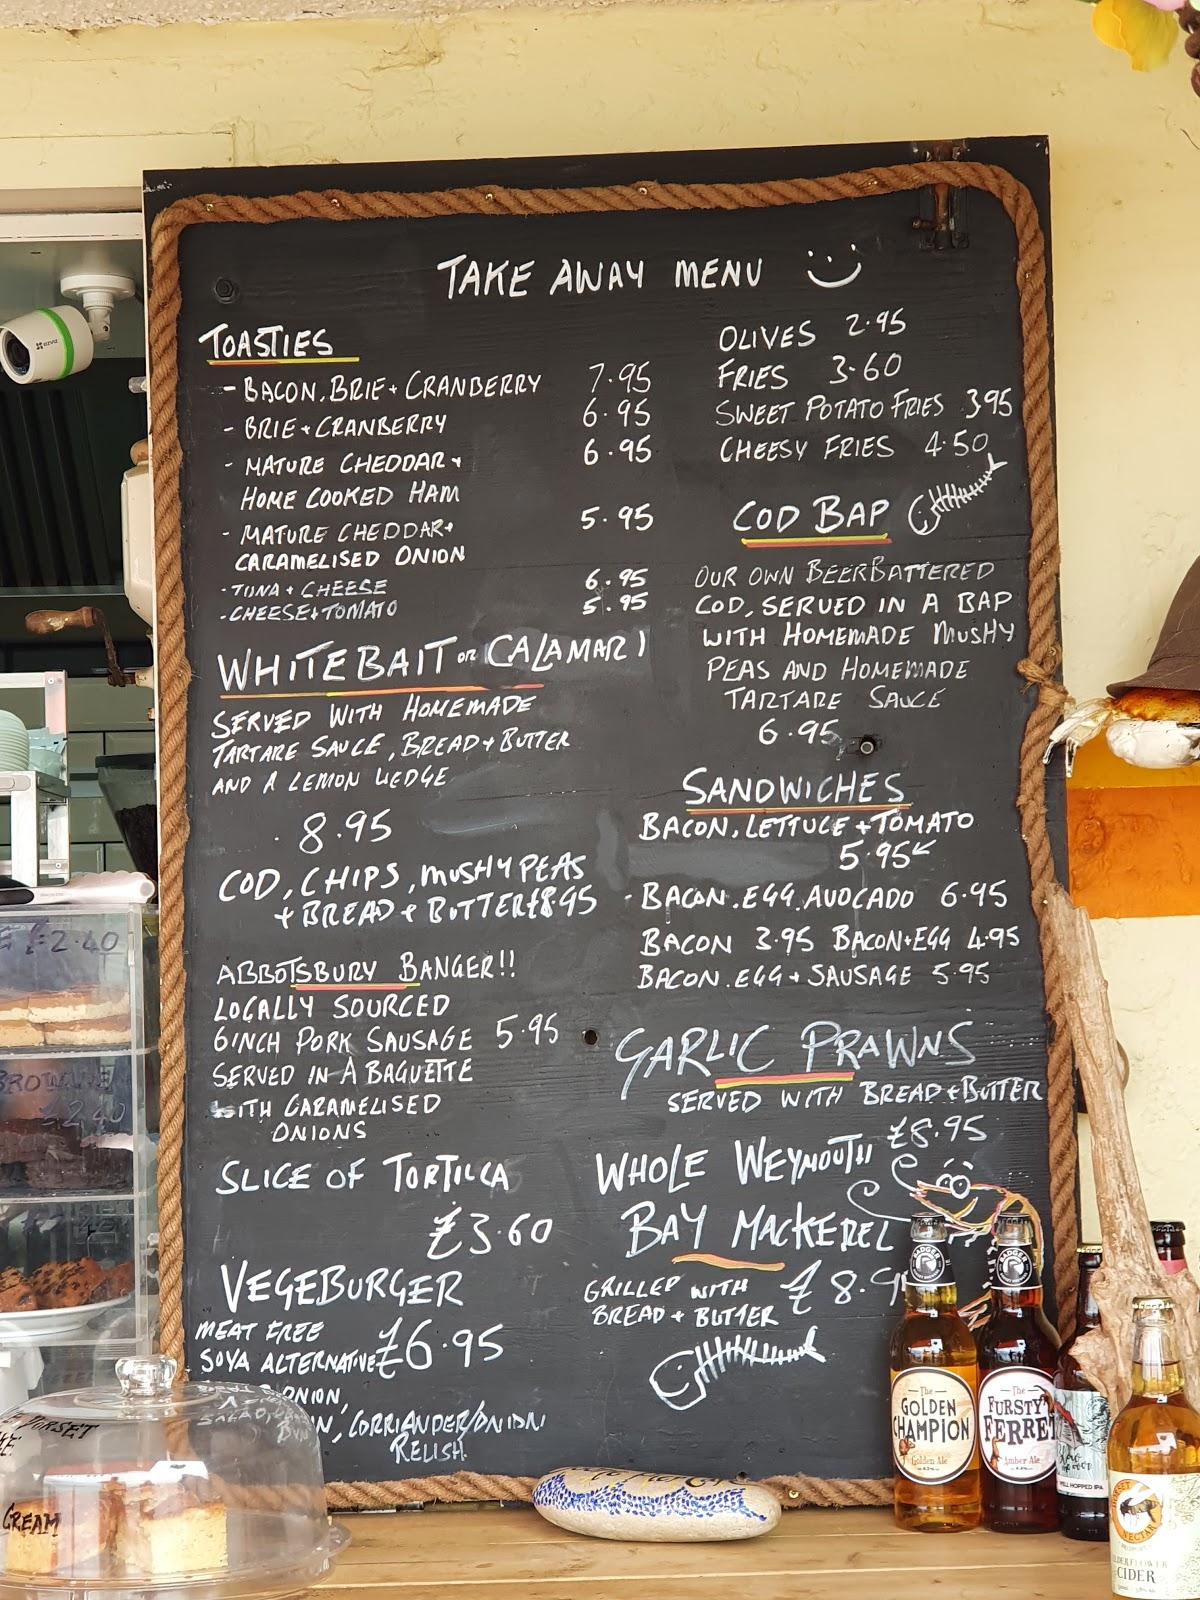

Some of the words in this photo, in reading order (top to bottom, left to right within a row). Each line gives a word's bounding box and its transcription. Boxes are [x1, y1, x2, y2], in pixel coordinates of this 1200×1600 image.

[437, 255, 535, 298] TAKE
[550, 260, 645, 296] AWAY
[675, 259, 763, 288] MENU
[198, 323, 334, 358] TOASTIES
[719, 321, 816, 351] OLIVES
[846, 308, 906, 336] 2.95
[405, 370, 542, 399] CRANBERRY
[589, 362, 651, 393] 7.95
[718, 359, 789, 391] FRIES
[829, 352, 902, 384] 3.60
[583, 398, 651, 428] 6.95
[716, 401, 796, 427] SWEET
[805, 395, 884, 422] POTATO
[891, 389, 944, 419] FRIES
[245, 417, 296, 439] BRIE
[315, 414, 447, 437] CRANBERRY
[583, 438, 652, 465] 6.95
[721, 437, 808, 462] CHEESY
[824, 436, 895, 459] FRIES
[925, 431, 989, 456] 4.50
[246, 457, 324, 477] MATURE
[340, 452, 446, 473] CHEDDAR
[241, 487, 296, 510] HOME
[306, 486, 393, 508] COOKED
[409, 481, 460, 503] HAM
[581, 503, 654, 531] 5.95
[733, 501, 800, 532] COD
[814, 495, 889, 533] BAP
[241, 524, 328, 545] MATURE
[235, 552, 380, 571] CARAMELISED
[396, 545, 466, 565] ONION
[301, 579, 388, 596] CHEESE
[585, 568, 649, 589] 6.95
[695, 566, 736, 588] OUR
[749, 566, 794, 585] OWN
[583, 592, 648, 615] 5.95
[762, 597, 865, 617] SERVED
[879, 597, 906, 613] IN
[922, 597, 939, 614] A
[958, 592, 1013, 613] BAP
[703, 627, 765, 647] WITH
[783, 625, 915, 646] HOMEMADE
[934, 620, 1016, 644] MUSHY
[485, 631, 646, 672] CALAMARI
[707, 657, 770, 682] PEAS
[783, 662, 827, 681] AND
[842, 657, 971, 680] HOMEMADE
[725, 688, 842, 710] TARTARE
[869, 686, 947, 709] SAUCE
[211, 709, 311, 739] SERVED
[329, 704, 383, 728] WITH
[402, 694, 537, 723] HOMEMADE
[759, 719, 840, 744] 6.95
[213, 744, 297, 768] TARTARE
[499, 728, 570, 753] BUTTER
[212, 776, 251, 795] AND
[263, 772, 278, 793] A
[288, 771, 360, 792] LEMON
[376, 767, 450, 788] WEDGE
[683, 767, 905, 805] SANDWICHES
[299, 809, 392, 854] 8.95
[746, 814, 850, 838] LETTUCE
[839, 841, 912, 870] 5.95
[421, 857, 512, 887] MUSHY
[521, 853, 586, 881] PEAS
[805, 885, 914, 910] AVOCADO
[941, 880, 1008, 909] 6.95
[302, 900, 395, 928] BREAD
[428, 893, 532, 924] BUTTER
[640, 928, 732, 956] BACON
[967, 925, 1020, 949] 4.95
[216, 956, 377, 985] ABBOTSBURY
[735, 965, 785, 988] EGG
[807, 965, 912, 986] SAUSAGE
[932, 962, 990, 985] 5.95
[214, 996, 314, 1022] LOCALLY
[333, 994, 450, 1020] SOURCED
[296, 1028, 352, 1054] PORK
[367, 1029, 472, 1052] SAUSAGE
[496, 1012, 559, 1049] 5.95
[212, 1064, 294, 1089] SERVED
[308, 1066, 329, 1083] IN
[340, 1058, 357, 1085] A
[366, 1058, 474, 1085] BAGUETTE
[615, 1024, 776, 1100] GARLIC
[801, 1021, 977, 1072] PRAWNS
[284, 1094, 441, 1118] CARAMELISED
[667, 1090, 762, 1114] SERVED
[781, 1088, 842, 1108] WITH
[859, 1080, 942, 1105] BREAD
[272, 1121, 367, 1142] ONIONS
[887, 1116, 987, 1147] £8.95
[215, 1160, 311, 1194] SLICE
[326, 1158, 366, 1189] OF
[382, 1152, 509, 1192] TORTILLA
[595, 1144, 709, 1194] WHOLE
[735, 1133, 872, 1185] WEYMOUTH
[427, 1205, 553, 1259] £3.60
[620, 1201, 707, 1257] BAY
[732, 1202, 894, 1251] MACKEREL
[913, 1247, 940, 1258] BADGER
[1000, 1250, 1027, 1262] BADGER
[220, 1260, 464, 1312] VEGEBURGER
[584, 1275, 681, 1302] GRILLED
[691, 1279, 748, 1300] WITH
[593, 1304, 665, 1326] BREAD
[694, 1303, 779, 1327] BUTTER
[195, 1320, 258, 1341] MEAT
[266, 1321, 324, 1342] FREE
[201, 1349, 250, 1373] SOYA
[260, 1350, 377, 1375] ALTERNATIVE
[376, 1317, 504, 1379] £6.95
[920, 1387, 933, 1396] The
[1012, 1386, 1025, 1396] The
[901, 1398, 956, 1416] GOLDEN
[988, 1396, 1041, 1415] FURSTY
[893, 1416, 969, 1443] CHAMPION
[911, 1456, 934, 1465] Golden
[938, 1456, 948, 1464] Ale
[1004, 1457, 1026, 1466] Amber
[2, 1502, 61, 1537] CREAM
[1123, 1524, 1156, 1541] NECTAR
[1117, 1567, 1156, 1583] CIDER
